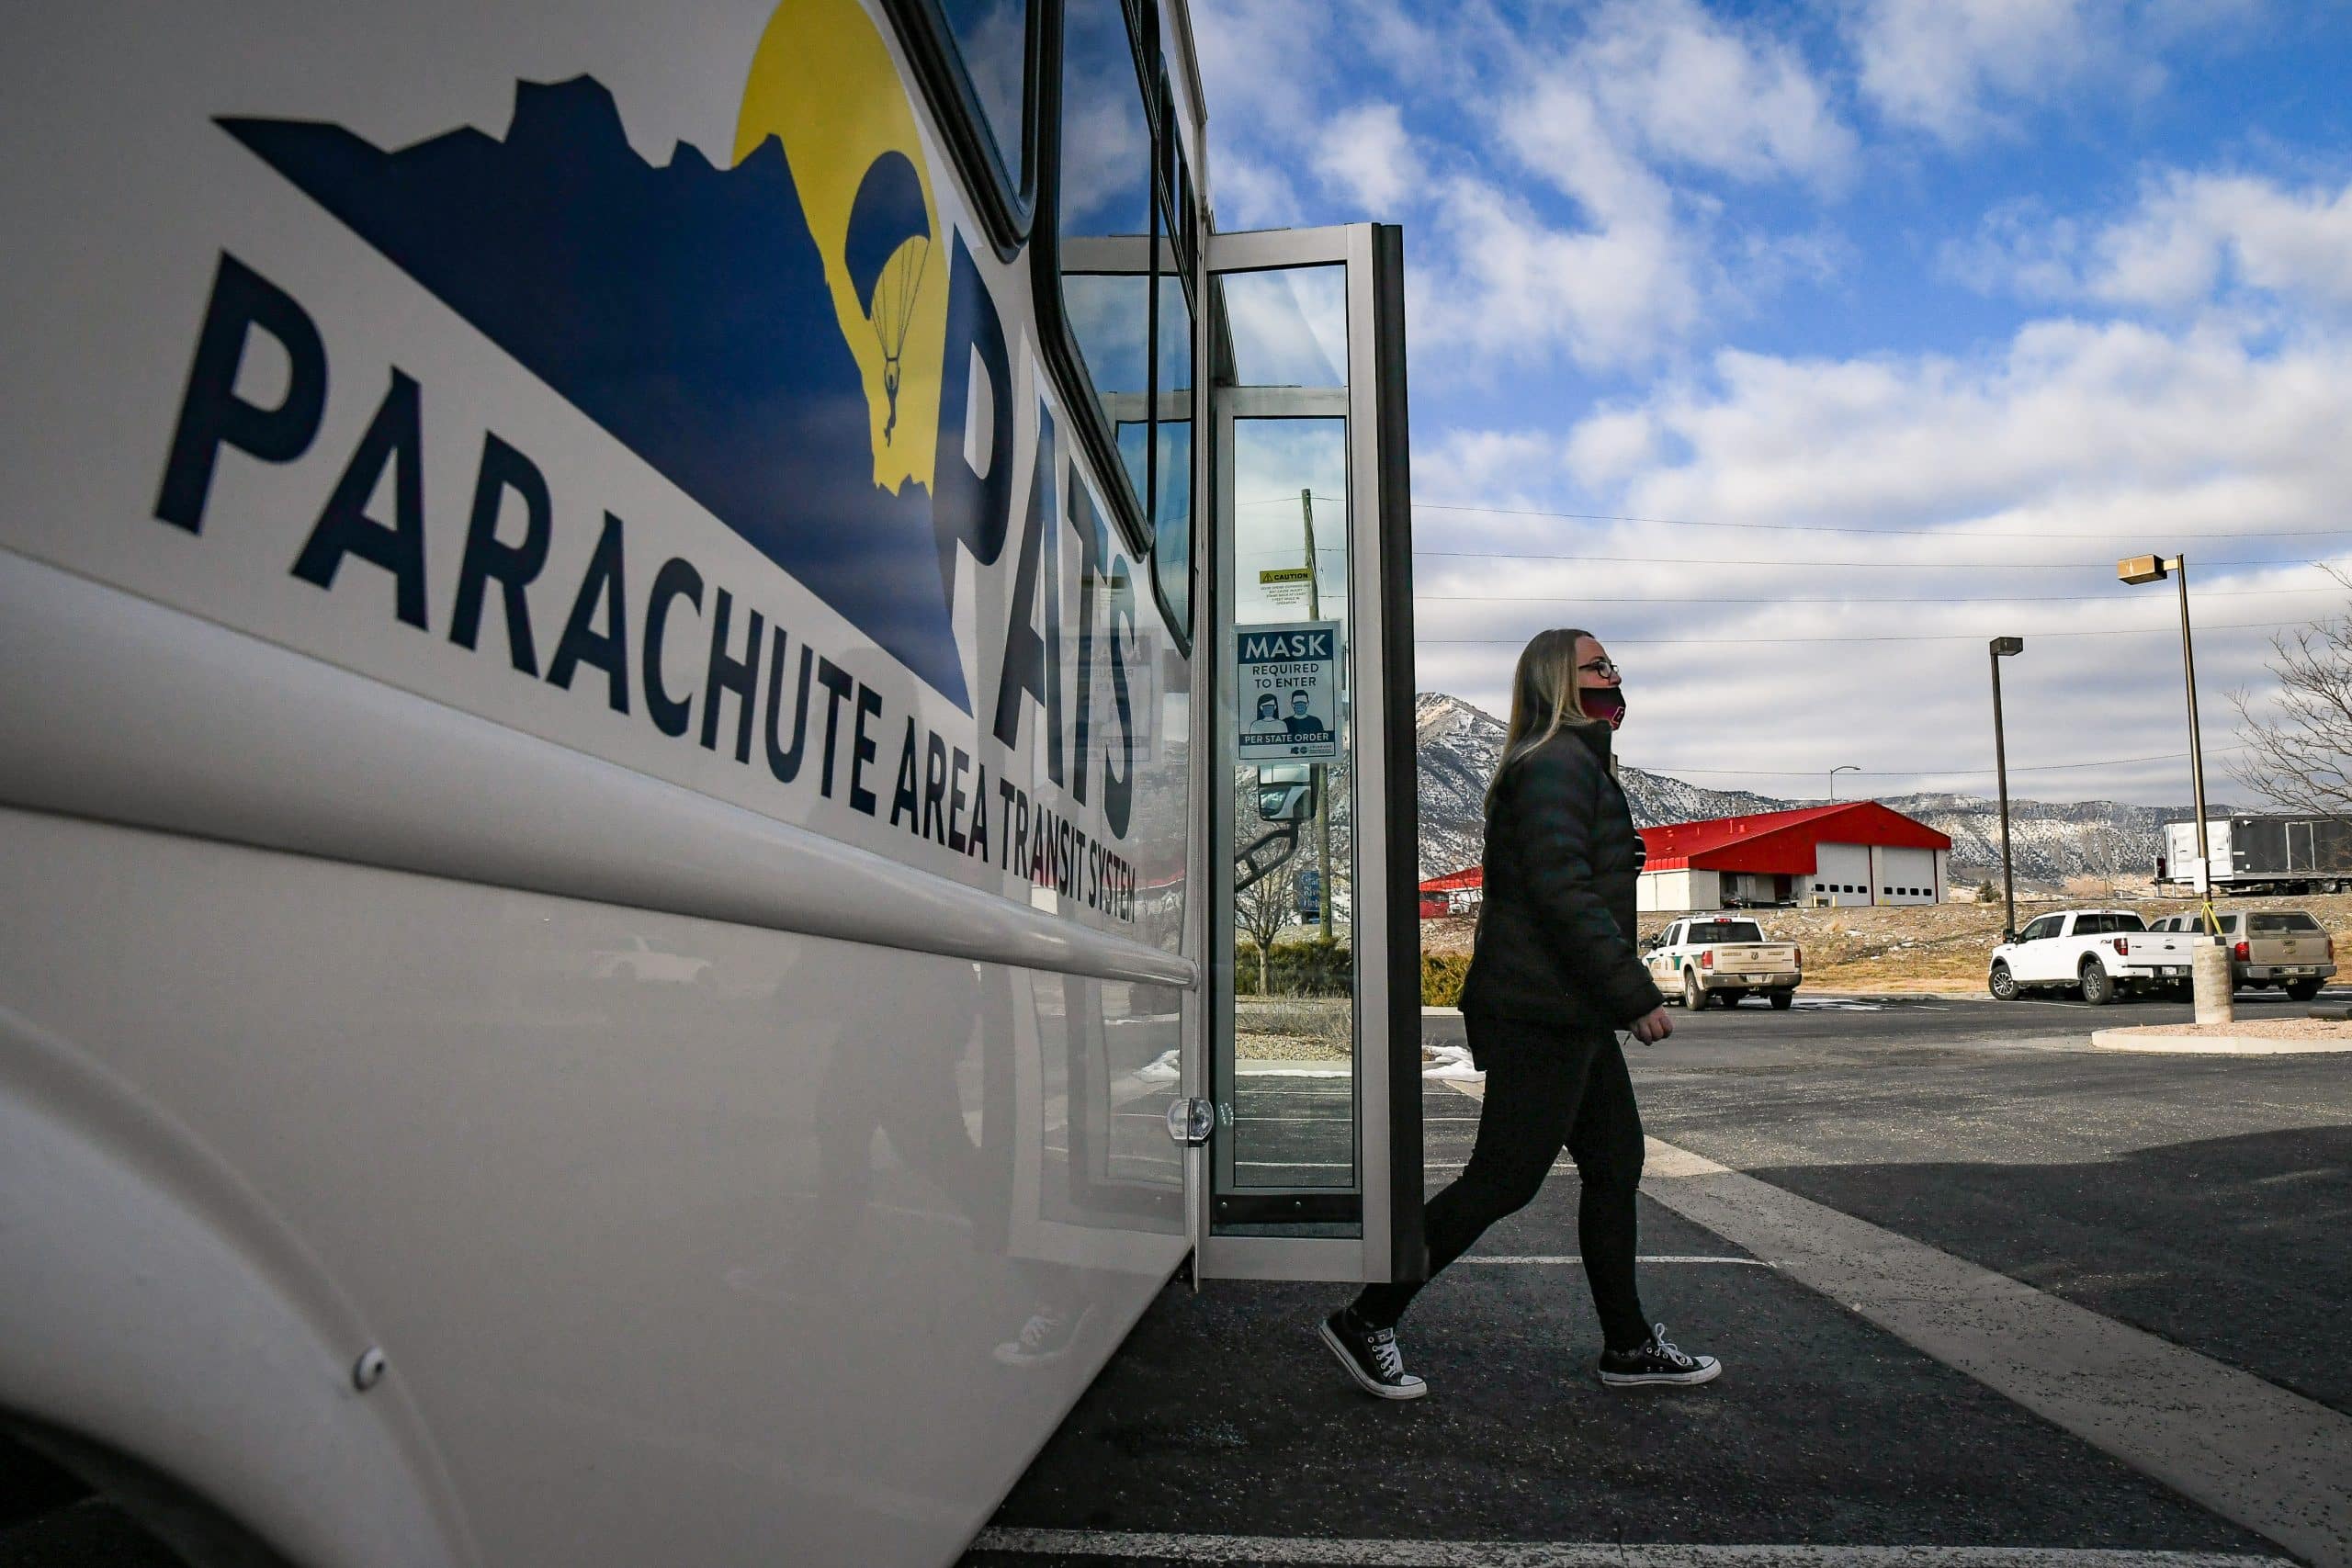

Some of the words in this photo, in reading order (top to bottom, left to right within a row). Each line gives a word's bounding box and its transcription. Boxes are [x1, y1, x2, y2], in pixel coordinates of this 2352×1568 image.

[932, 220, 1136, 840] PATS
[1273, 572, 1308, 581] CAUTION
[153, 247, 882, 817] PARACHUTE
[889, 715, 989, 863] AREA
[1000, 776, 1086, 902] TRANSIT
[1088, 838, 1136, 924] SYSTEM
[1245, 634, 1327, 660] MASK
[1252, 663, 1319, 677] REQUIRED
[1254, 678, 1272, 689] TO
[1275, 676, 1317, 688] ENTER
[1244, 735, 1263, 744] PER
[1265, 734, 1293, 743] STATE
[1295, 732, 1329, 742] ORDER
